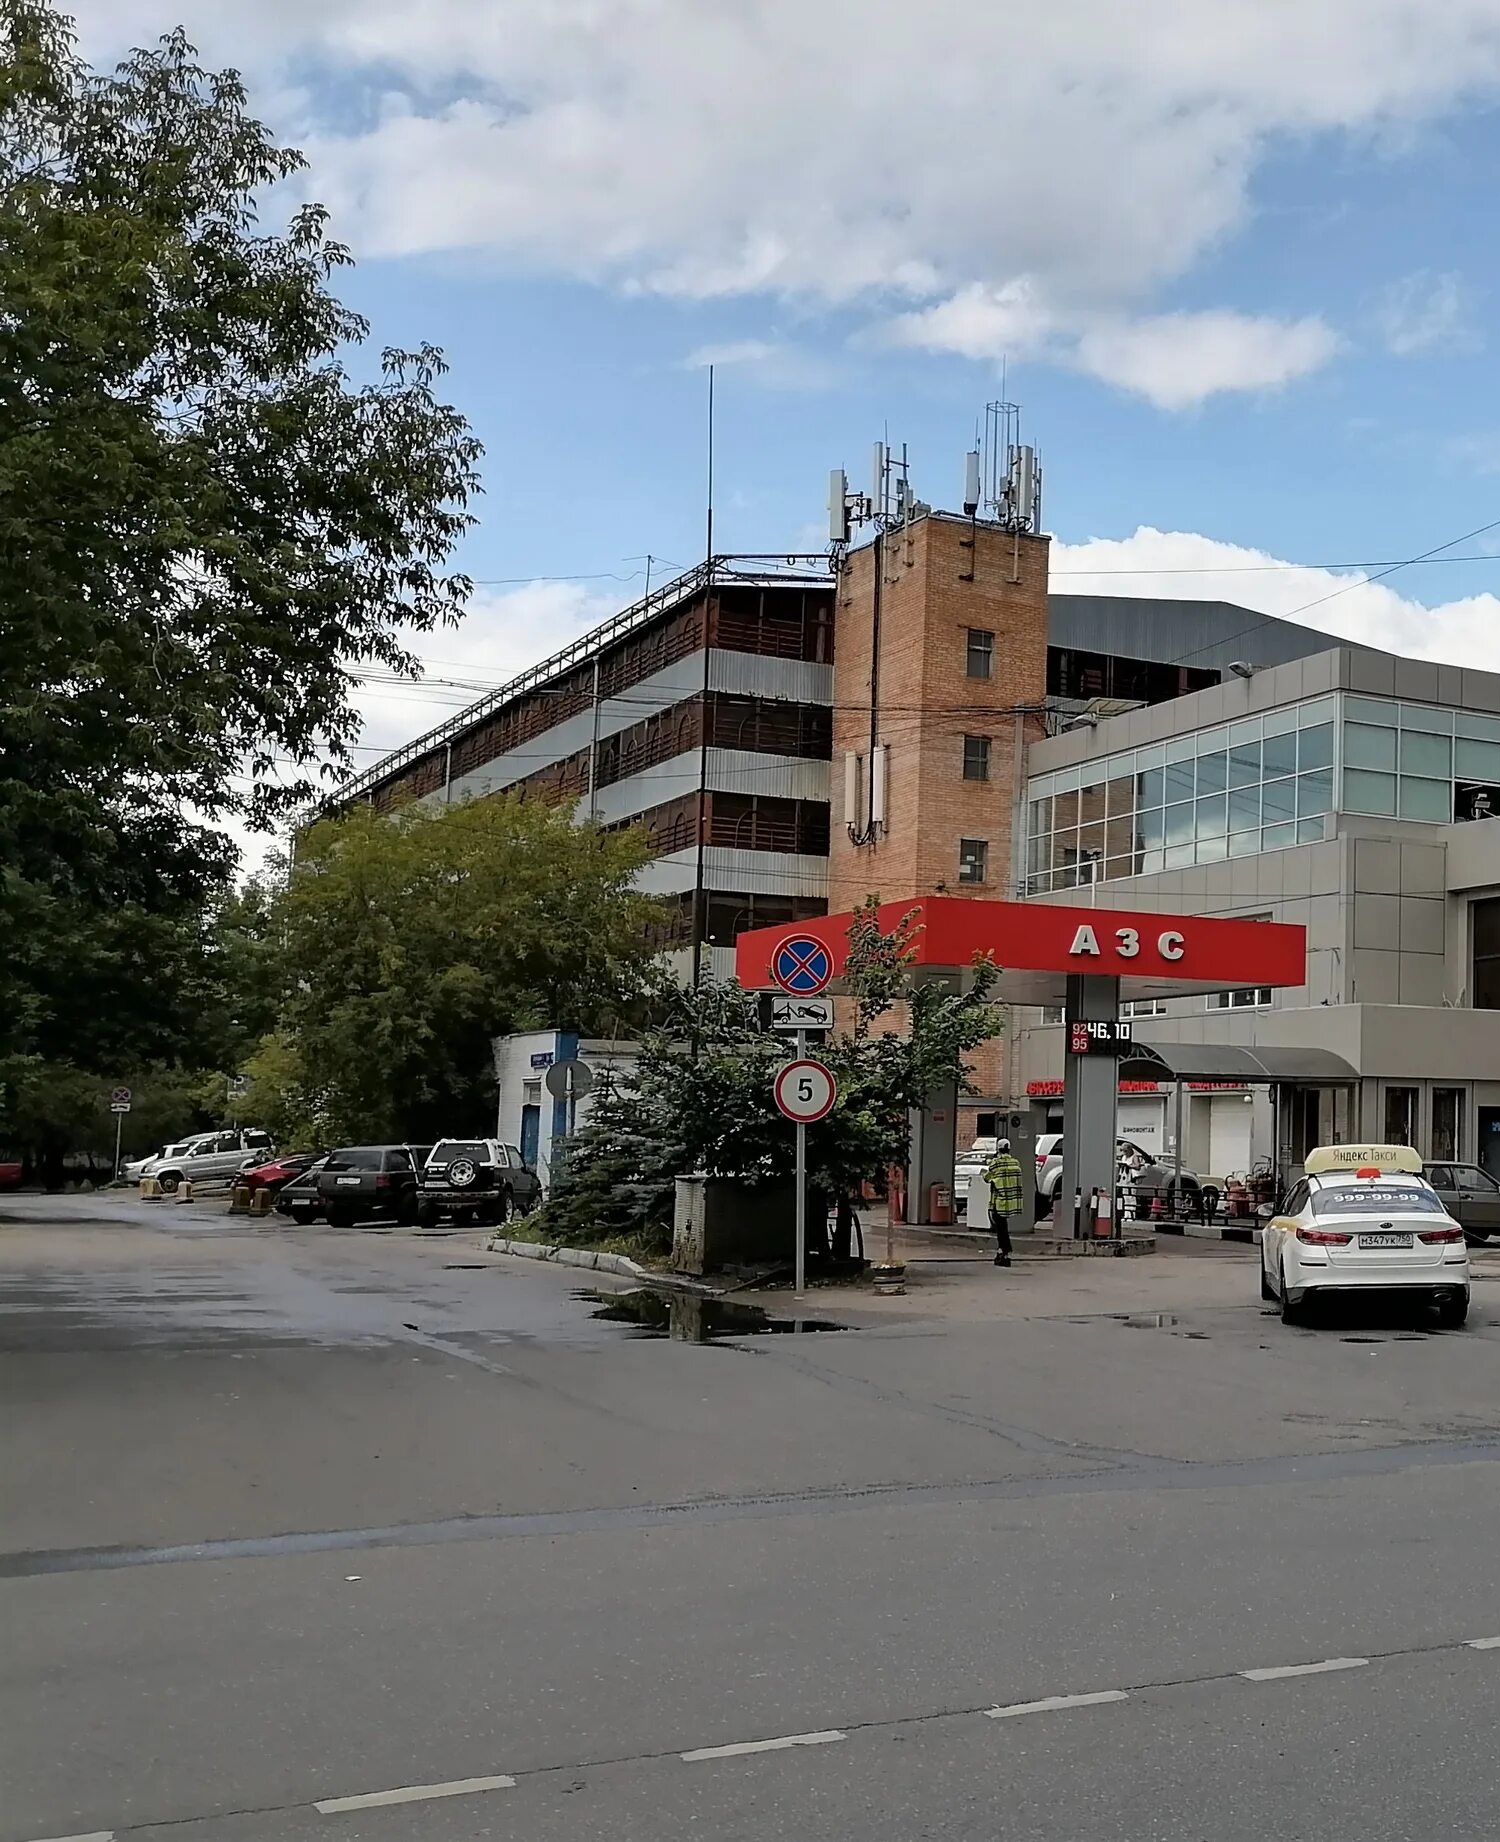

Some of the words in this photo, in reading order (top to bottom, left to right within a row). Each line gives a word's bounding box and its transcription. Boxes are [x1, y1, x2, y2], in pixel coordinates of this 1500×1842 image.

[1069, 925, 1185, 960] АЗС
[1073, 1023, 1088, 1035] 92
[1071, 1038, 1087, 1050] 95
[798, 1078, 813, 1102] 5
[1333, 1150, 1367, 1161] Яндекс
[1369, 1148, 1397, 1161] Такси
[1334, 1193, 1420, 1203] 999-99-99
